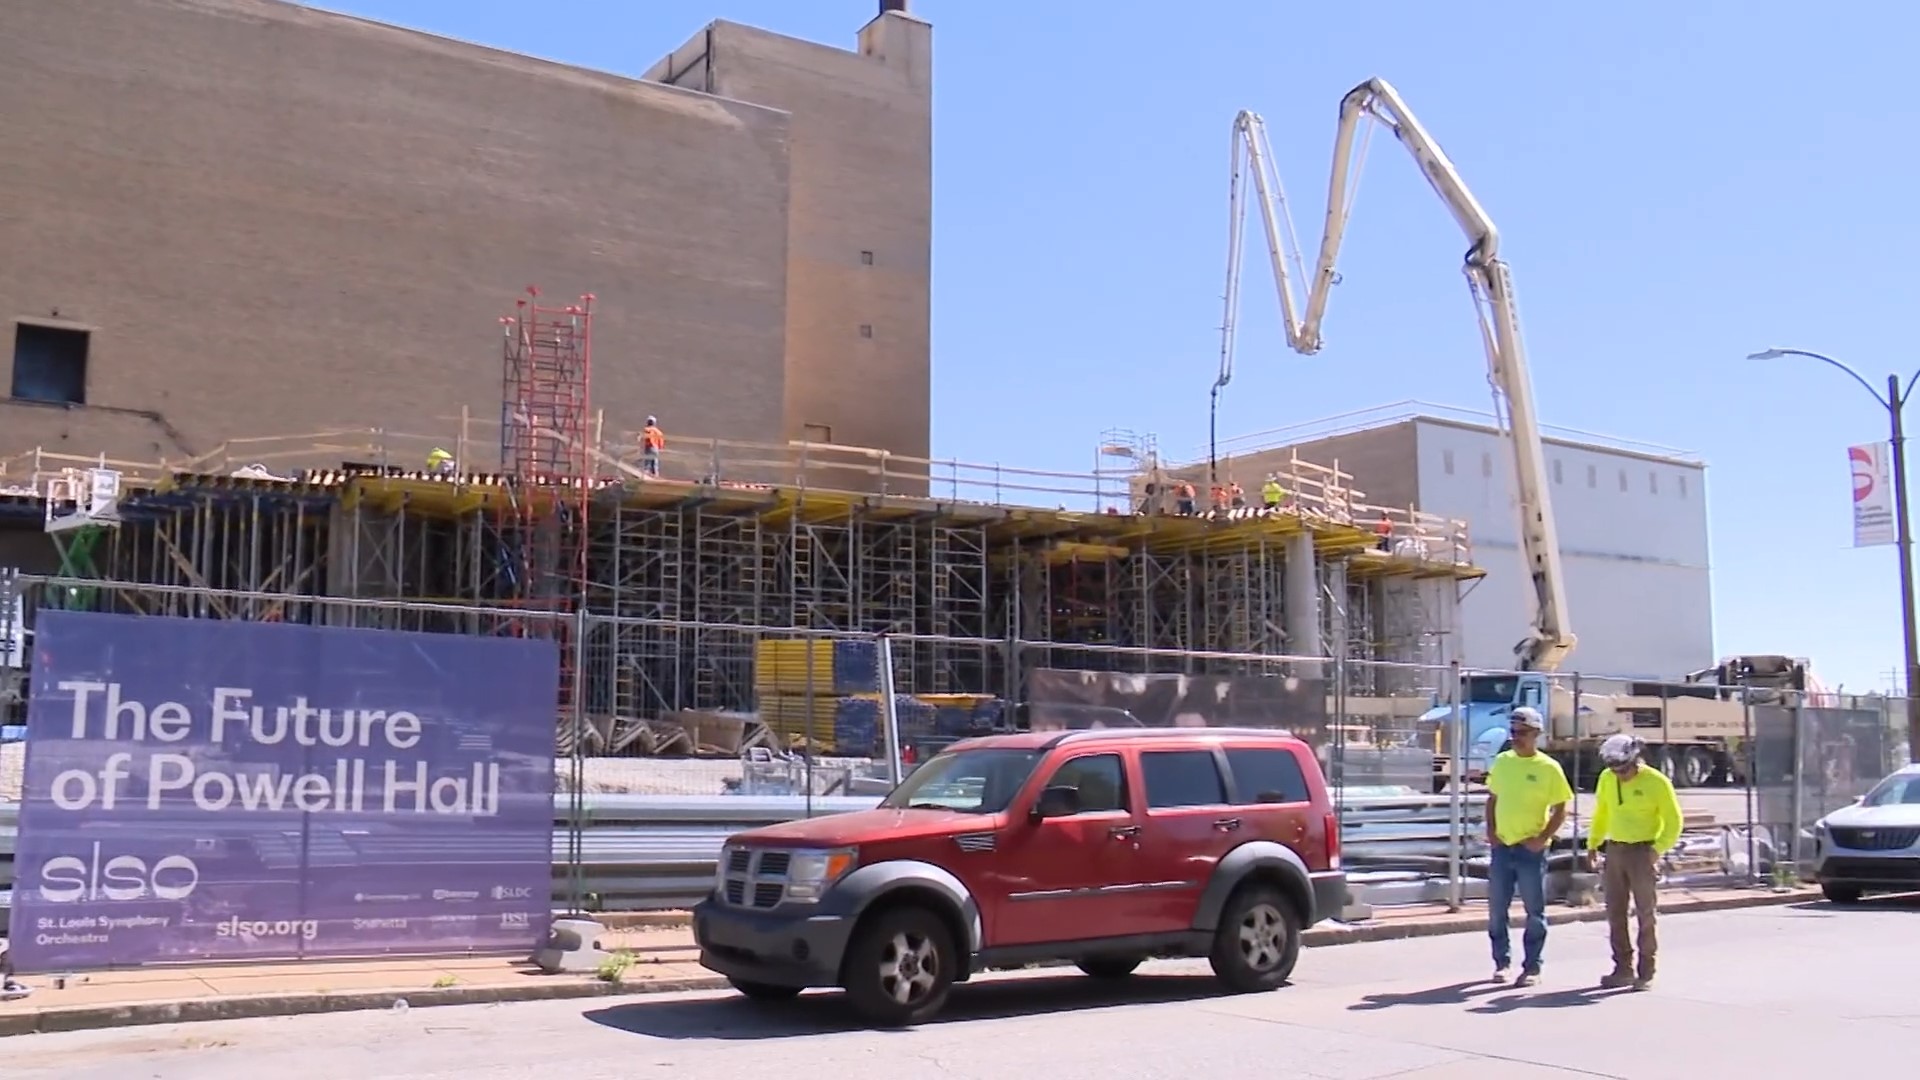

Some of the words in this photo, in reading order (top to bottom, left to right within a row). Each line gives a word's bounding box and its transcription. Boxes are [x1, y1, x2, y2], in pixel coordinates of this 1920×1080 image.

[59, 681, 191, 741] The
[212, 687, 422, 749] Future
[51, 753, 130, 811] of
[147, 753, 364, 813] Powell
[384, 759, 499, 816] Hall
[39, 840, 199, 902] slso
[36, 933, 109, 945] Orchestra
[37, 917, 57, 929] St.
[59, 917, 96, 929] Louis
[98, 915, 169, 930] Symphony
[216, 915, 318, 940] slso.org
